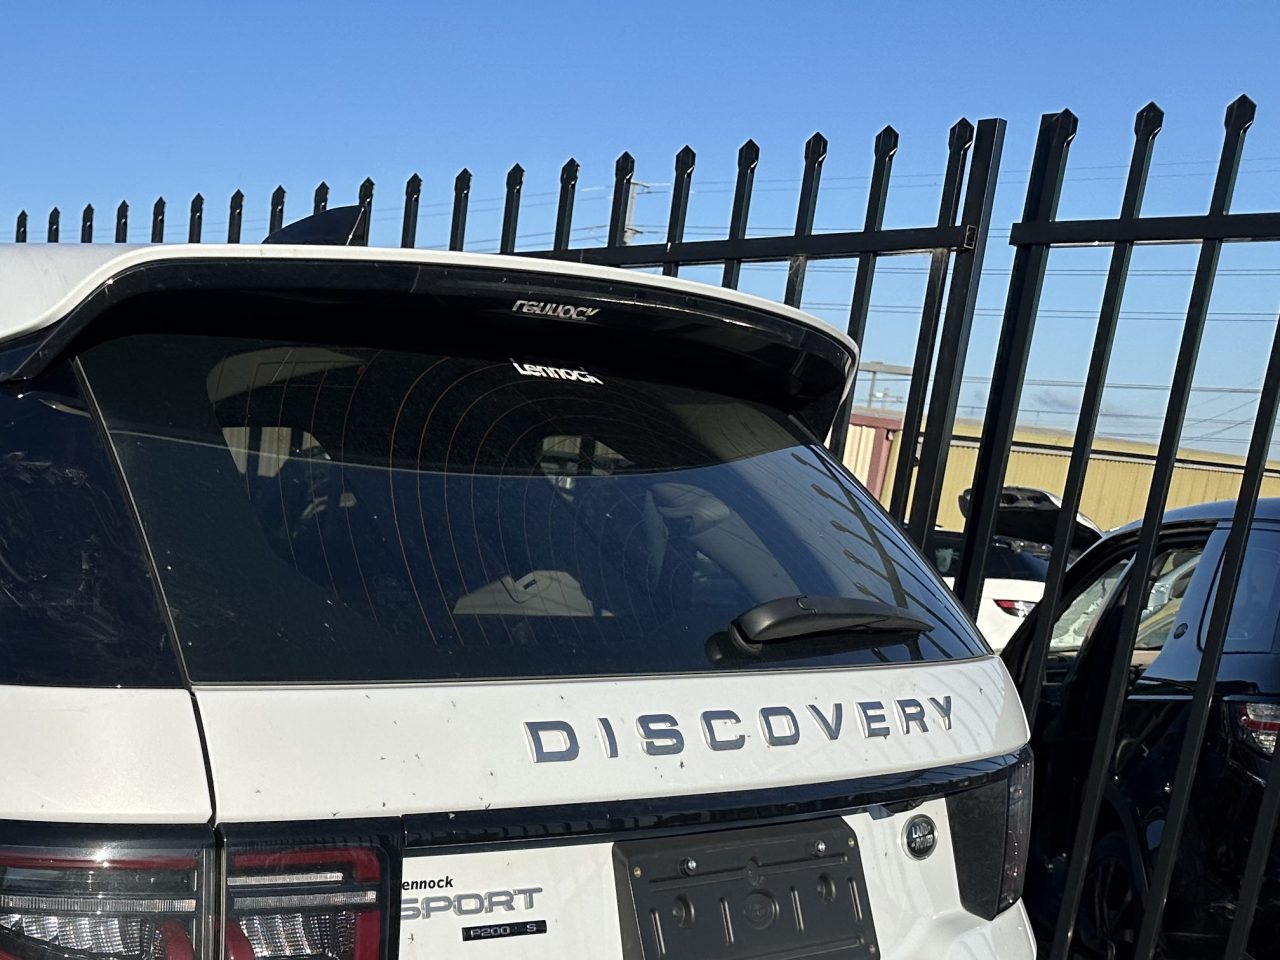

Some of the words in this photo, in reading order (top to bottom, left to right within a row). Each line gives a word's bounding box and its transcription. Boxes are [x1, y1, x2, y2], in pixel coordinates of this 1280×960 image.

[522, 695, 952, 763] DISCOVERY
[402, 876, 454, 890] ennock
[401, 887, 543, 921] SPORT
[470, 925, 510, 937] P200
[526, 923, 537, 933] S
